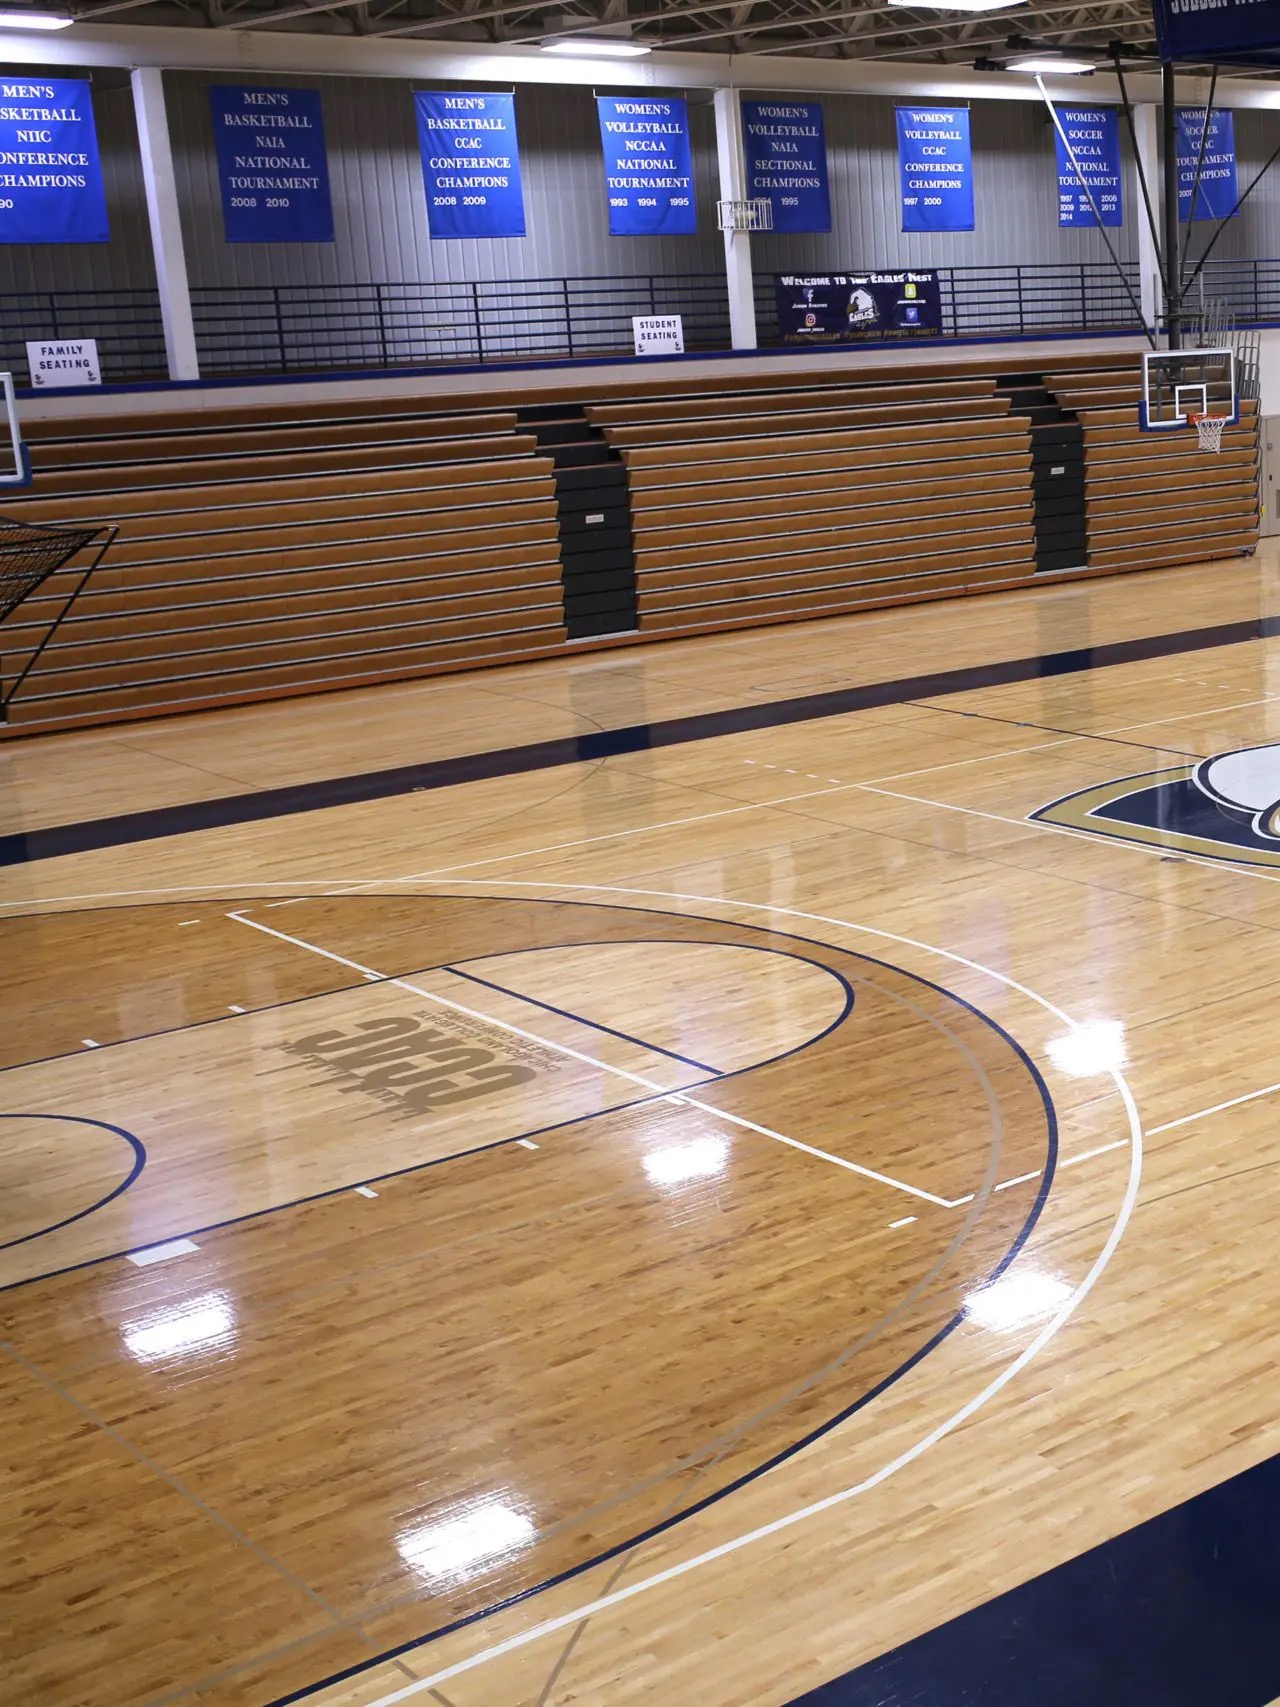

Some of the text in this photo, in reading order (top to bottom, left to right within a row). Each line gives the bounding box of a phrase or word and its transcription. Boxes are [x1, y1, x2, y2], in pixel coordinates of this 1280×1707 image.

[2, 85, 55, 98] MEN'S
[243, 92, 289, 106] MEN'S
[444, 97, 486, 110] MEN'S
[615, 103, 671, 115] WOMEN'S
[757, 106, 808, 118] WOMEN'S
[223, 113, 312, 128] BASKETBALL
[912, 113, 954, 123] WOMEN'S
[1065, 112, 1107, 123] WOMEN'S
[427, 118, 506, 130] BASKETBALL
[605, 121, 683, 134] VOLLEYBALL
[748, 124, 819, 137] VOLLEYBALL
[904, 130, 962, 140] VOLLEYBALL
[1068, 130, 1104, 140] SOCCER
[16, 130, 52, 143] NIIC
[255, 136, 285, 149] NAIA
[454, 137, 482, 149] CCAC
[625, 140, 666, 151] NCCAA
[771, 142, 799, 153] NAIA
[922, 146, 946, 156] CCAC
[1071, 145, 1102, 156] NCCAA
[235, 156, 311, 169] NATIONAL
[429, 157, 512, 169] CONFERENCE
[616, 159, 677, 170] NATIONAL
[755, 160, 817, 171] SECTIONAL
[905, 163, 964, 172] CONFERENCE
[228, 176, 320, 189] TOURNAMENT
[436, 176, 509, 188] CHAMPIONS
[607, 177, 690, 188] TOURNAMENT
[753, 177, 820, 188] CHAMPIONS
[909, 180, 962, 189] CHAMPIONS
[231, 197, 290, 207] 2008 2010
[433, 196, 486, 206] 2008 2009
[609, 197, 690, 206] 1993 1994 1995
[780, 197, 799, 206] 1995
[781, 275, 831, 286] WELCOME
[834, 276, 846, 285] TO
[639, 320, 676, 329] STUDENT
[641, 332, 677, 340] SEATING
[41, 345, 82, 356] FAMILY
[39, 359, 90, 370] SEATING
